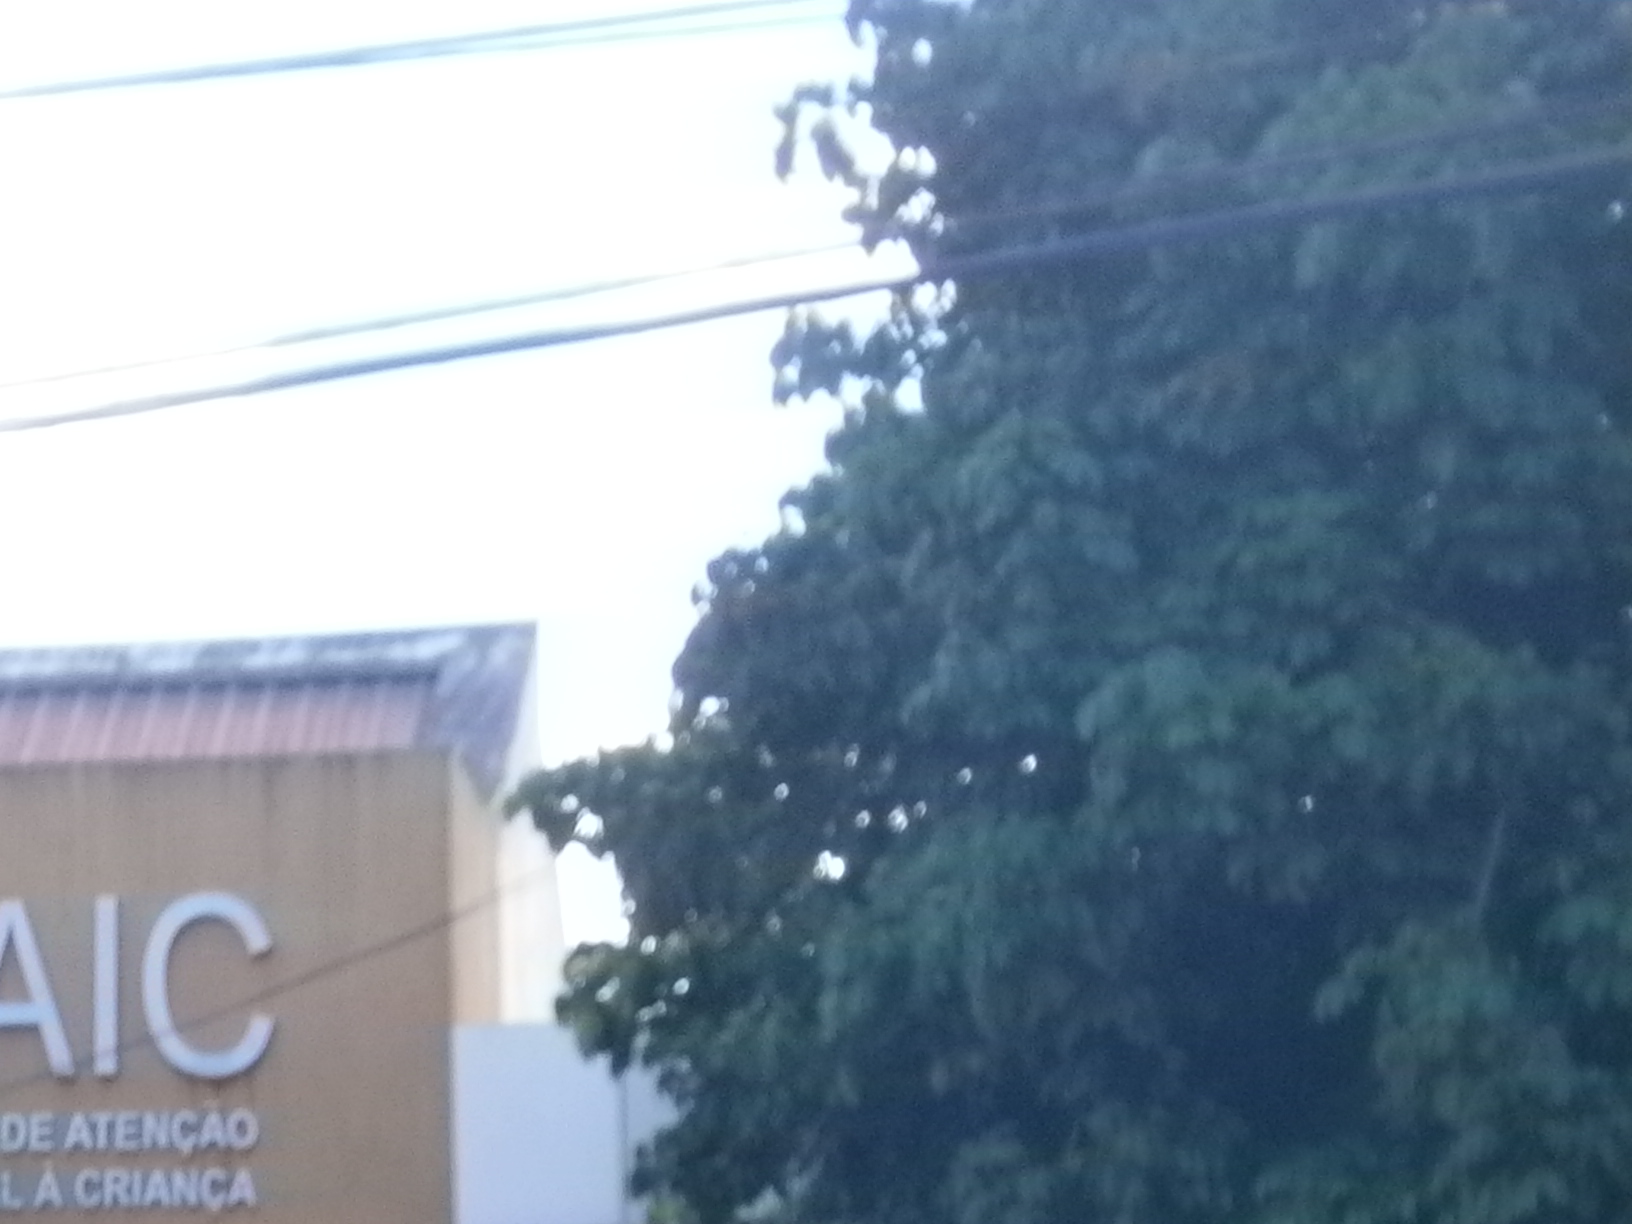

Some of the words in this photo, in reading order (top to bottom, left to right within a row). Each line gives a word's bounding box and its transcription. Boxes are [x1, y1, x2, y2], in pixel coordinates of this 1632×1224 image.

[0, 1111, 56, 1152] DE
[65, 1103, 258, 1158] ATENÇÃO
[74, 1166, 257, 1211] CRIANÇA
